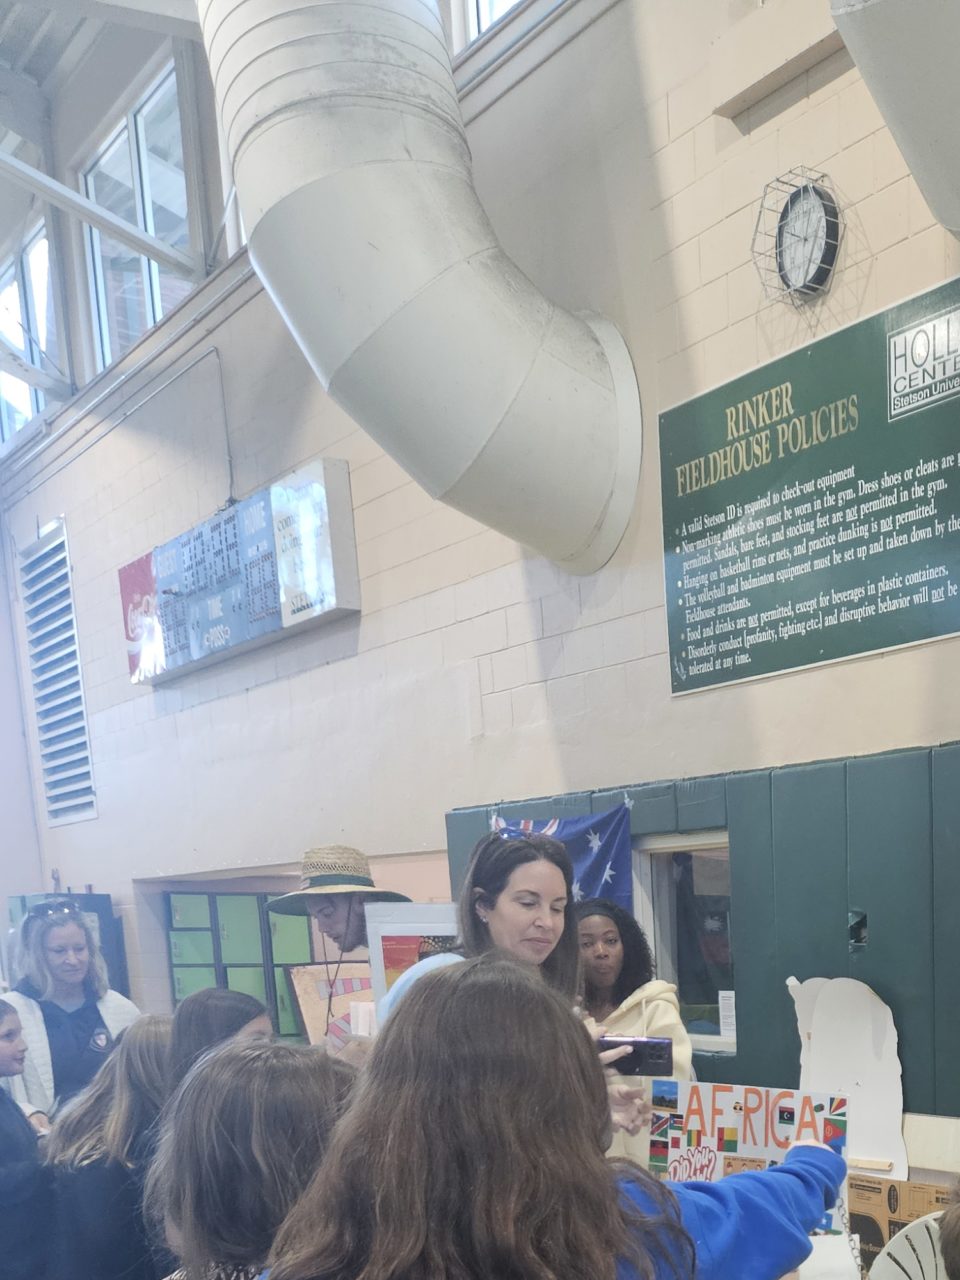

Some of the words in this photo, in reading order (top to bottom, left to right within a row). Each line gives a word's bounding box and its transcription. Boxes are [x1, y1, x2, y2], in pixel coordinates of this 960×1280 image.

[725, 381, 794, 441] RINKER
[894, 390, 929, 409] Stetson
[675, 430, 772, 496] FIELDHOUSE
[777, 394, 859, 458] POLICIES
[682, 523, 687, 536] A
[688, 516, 702, 534] valid
[704, 512, 725, 530] Stetson
[727, 504, 735, 519] ID
[737, 505, 742, 517] is
[745, 495, 771, 516] required
[773, 493, 780, 503] to
[782, 482, 814, 501] check-out
[817, 465, 855, 494] equipment
[682, 534, 721, 555] Non-marking
[723, 522, 745, 540] athletic
[747, 517, 763, 534] shoes
[766, 510, 782, 527] must
[784, 506, 792, 520] be
[795, 503, 811, 517] worn
[814, 498, 821, 511] in
[824, 494, 835, 507] the
[838, 487, 856, 507] gym.
[858, 480, 879, 496] Dress
[881, 472, 901, 488] shoes
[904, 470, 913, 481] or
[916, 459, 938, 477] cleats
[941, 455, 954, 468] are
[683, 552, 712, 574] permitted.
[714, 542, 739, 560] Sandals,
[741, 540, 754, 554] bare
[756, 533, 770, 551] feet,
[772, 530, 784, 542] and
[786, 519, 814, 538] stocking
[817, 513, 829, 528] feet
[832, 510, 843, 524] are
[846, 506, 857, 522] not
[860, 487, 897, 518] permitted
[900, 487, 909, 503] in
[912, 481, 924, 499] the
[928, 478, 947, 498] gym.
[684, 573, 709, 589] Hanging
[710, 570, 717, 580] on
[720, 560, 750, 578] basketball
[752, 554, 767, 568] rims
[768, 552, 775, 561] or
[776, 548, 792, 561] nets,
[794, 542, 806, 556] and
[809, 534, 835, 555] practice
[838, 518, 869, 542] dunking
[872, 518, 878, 532] is
[880, 515, 893, 532] not
[896, 499, 937, 526] permitted.
[685, 594, 696, 607] The
[698, 584, 725, 603] volleyball
[727, 579, 738, 593] and
[741, 575, 774, 591] badminton
[776, 559, 811, 582] equipment
[814, 554, 831, 570] must
[833, 550, 842, 564] be
[843, 549, 855, 562] set
[857, 544, 867, 560] up
[869, 536, 883, 554] and
[886, 531, 908, 550] taken
[911, 525, 932, 542] down
[935, 519, 945, 538] by
[948, 514, 960, 532] the
[686, 606, 716, 623] Fieldhouse
[717, 598, 751, 614] attendants.
[687, 628, 700, 641] Food
[703, 626, 714, 637] and
[716, 618, 735, 634] drinks
[737, 615, 747, 627] are
[748, 613, 759, 627] not
[761, 601, 794, 626] permitted,
[795, 597, 817, 617] except
[819, 592, 830, 605] for
[832, 587, 865, 606] beverages
[868, 580, 875, 596] in
[878, 573, 902, 594] plastic
[905, 564, 948, 584] containers.
[688, 643, 717, 659] Disorderly
[719, 636, 742, 651] conduct
[779, 620, 806, 639] fighting
[825, 611, 838, 625] and
[840, 601, 875, 622] disruptive
[878, 594, 910, 613] behavior
[913, 586, 928, 604] will
[932, 586, 945, 603] not
[948, 581, 957, 597] be
[689, 658, 713, 675] tolerated
[715, 658, 721, 669] at
[723, 657, 733, 669] any
[735, 651, 751, 665] time.
[682, 1085, 820, 1150] AFRICA
